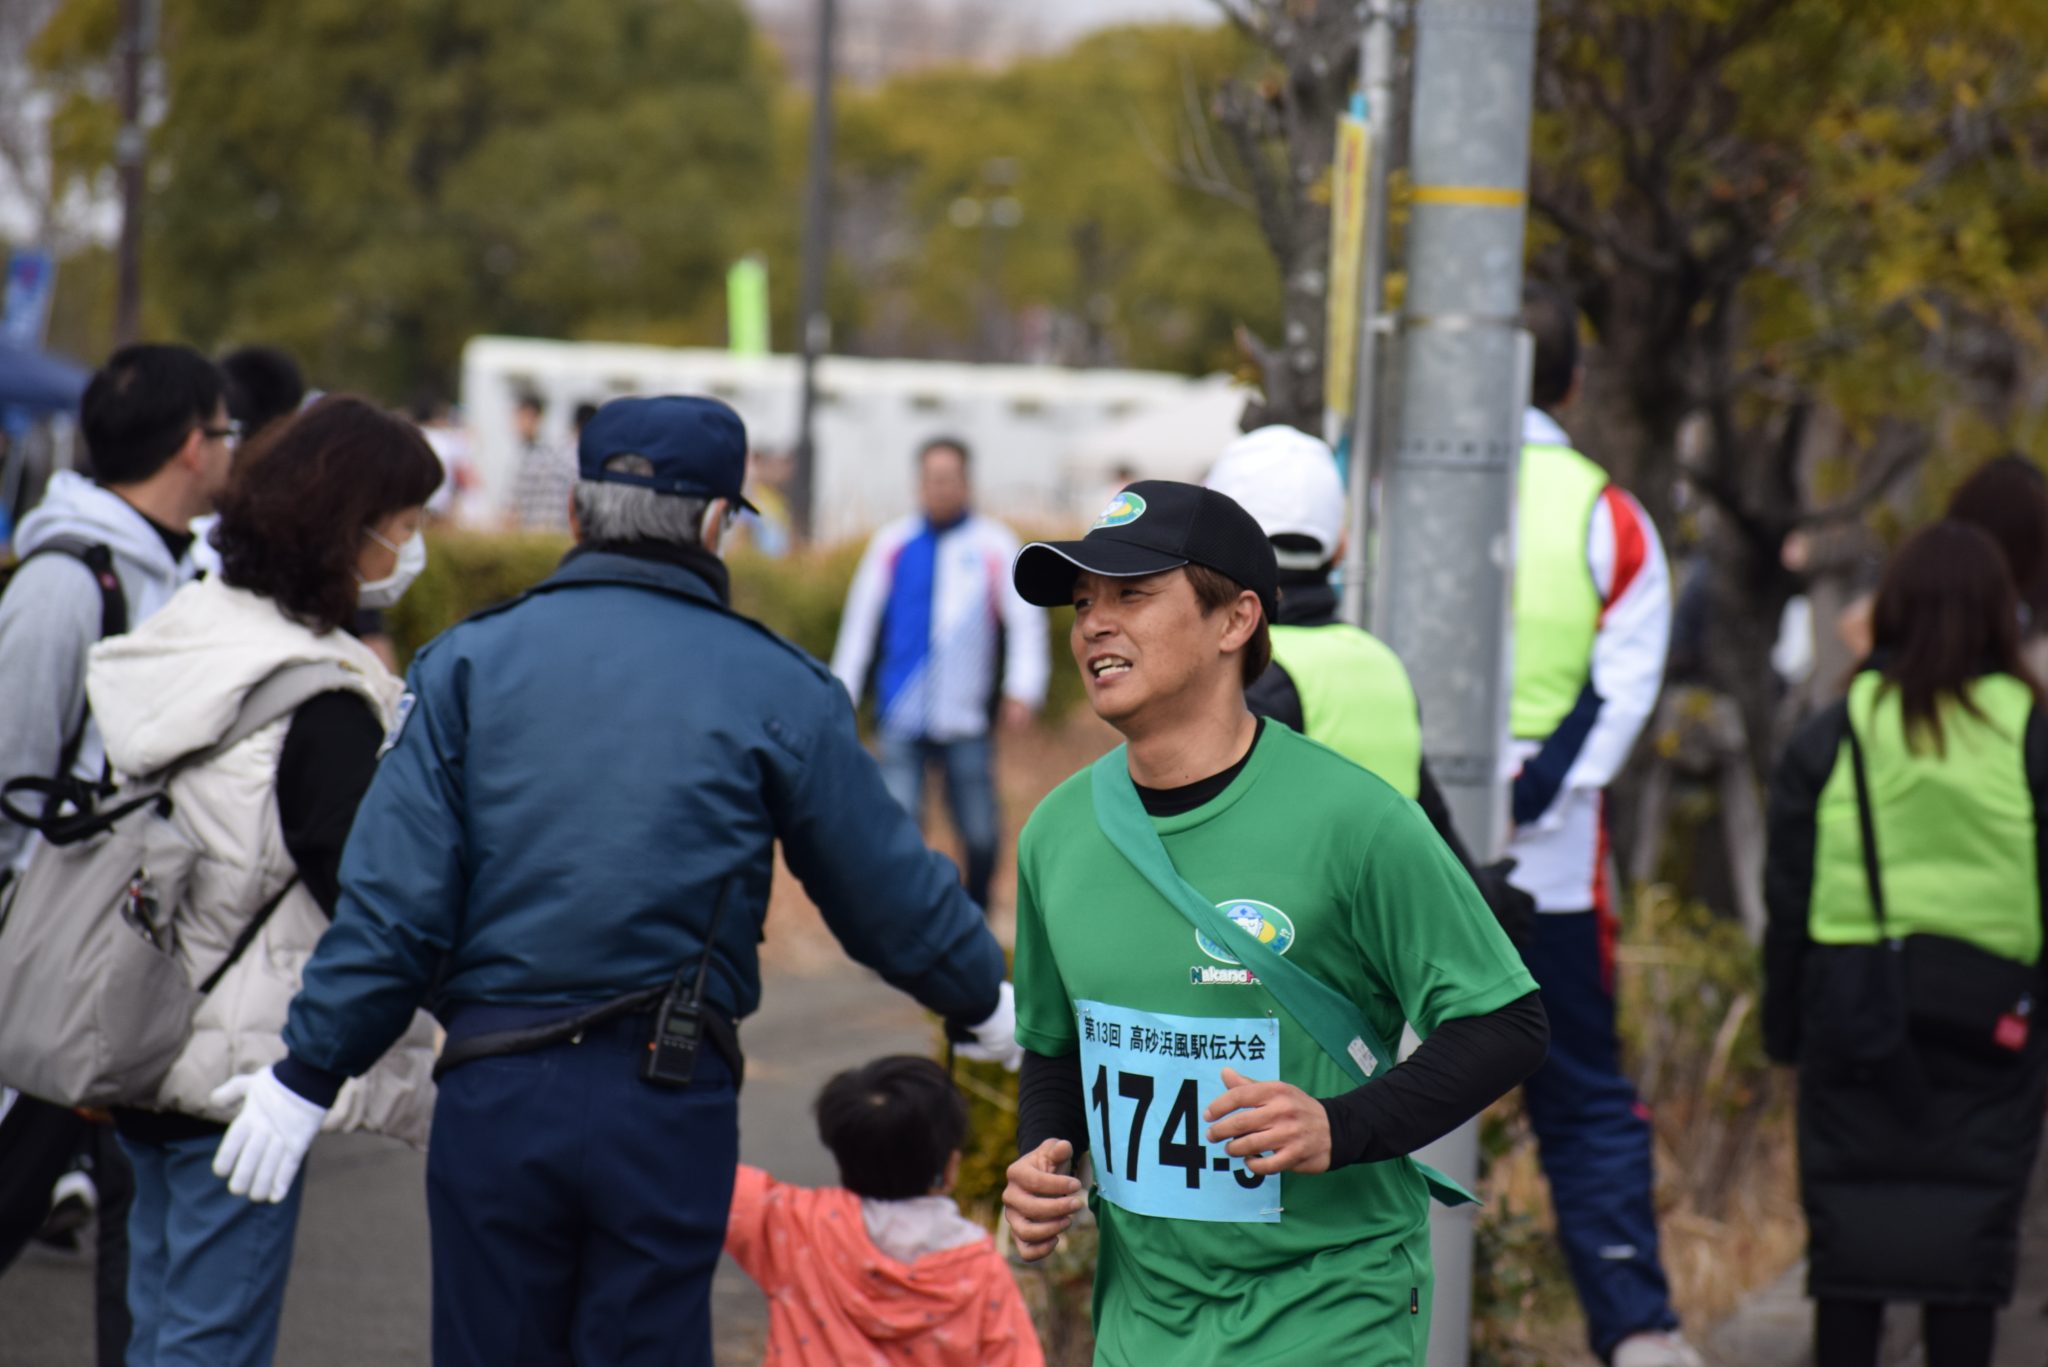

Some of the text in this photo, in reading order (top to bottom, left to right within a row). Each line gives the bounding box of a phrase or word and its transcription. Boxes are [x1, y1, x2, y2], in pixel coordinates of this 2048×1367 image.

[1084, 1017, 1266, 1061] 第13回 高砂浜風駅伝大会
